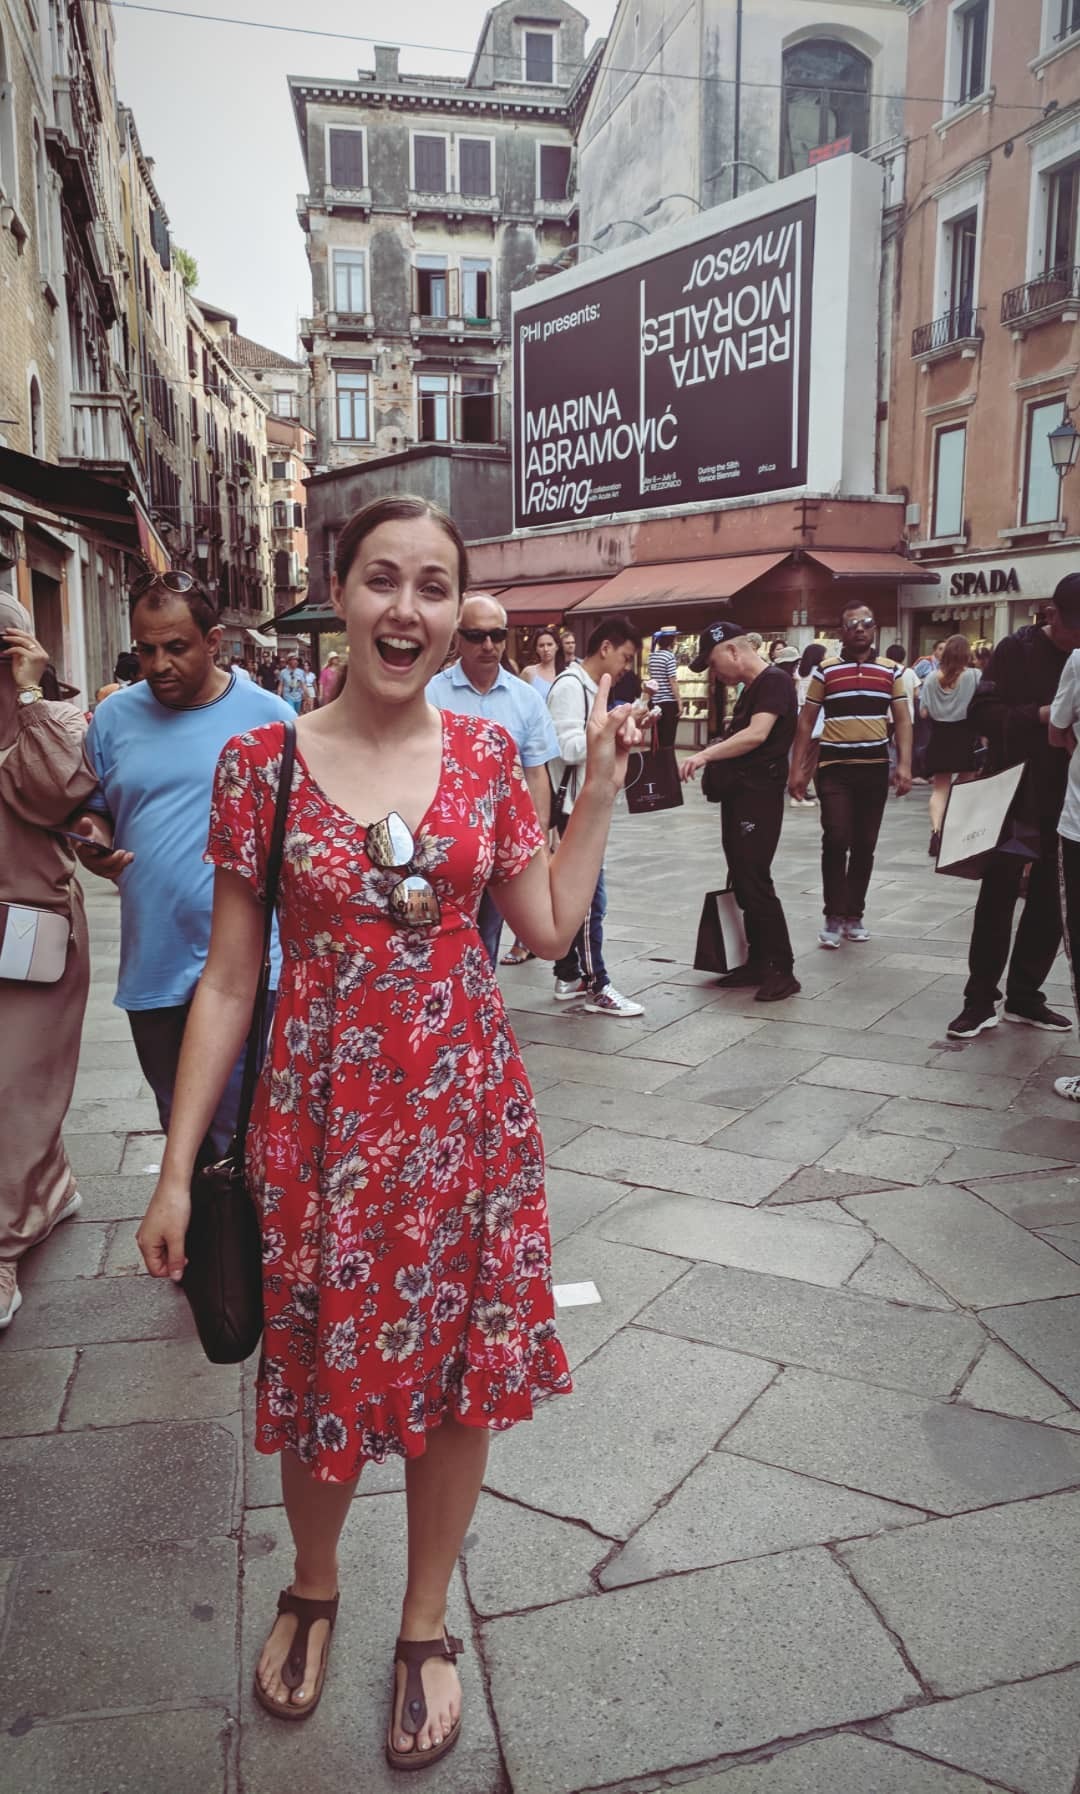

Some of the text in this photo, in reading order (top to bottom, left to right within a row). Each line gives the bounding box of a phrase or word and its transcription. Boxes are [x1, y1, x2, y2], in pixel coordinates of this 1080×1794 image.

[682, 222, 795, 293] Invasor
[520, 303, 600, 342] PHI presents:
[641, 272, 791, 356] MORALES
[669, 319, 791, 388] RENATA
[526, 388, 622, 443] MARINA
[526, 404, 678, 479] ABRAMOVIĆ
[526, 475, 592, 514] Rising
[950, 567, 1021, 597] SPADA
